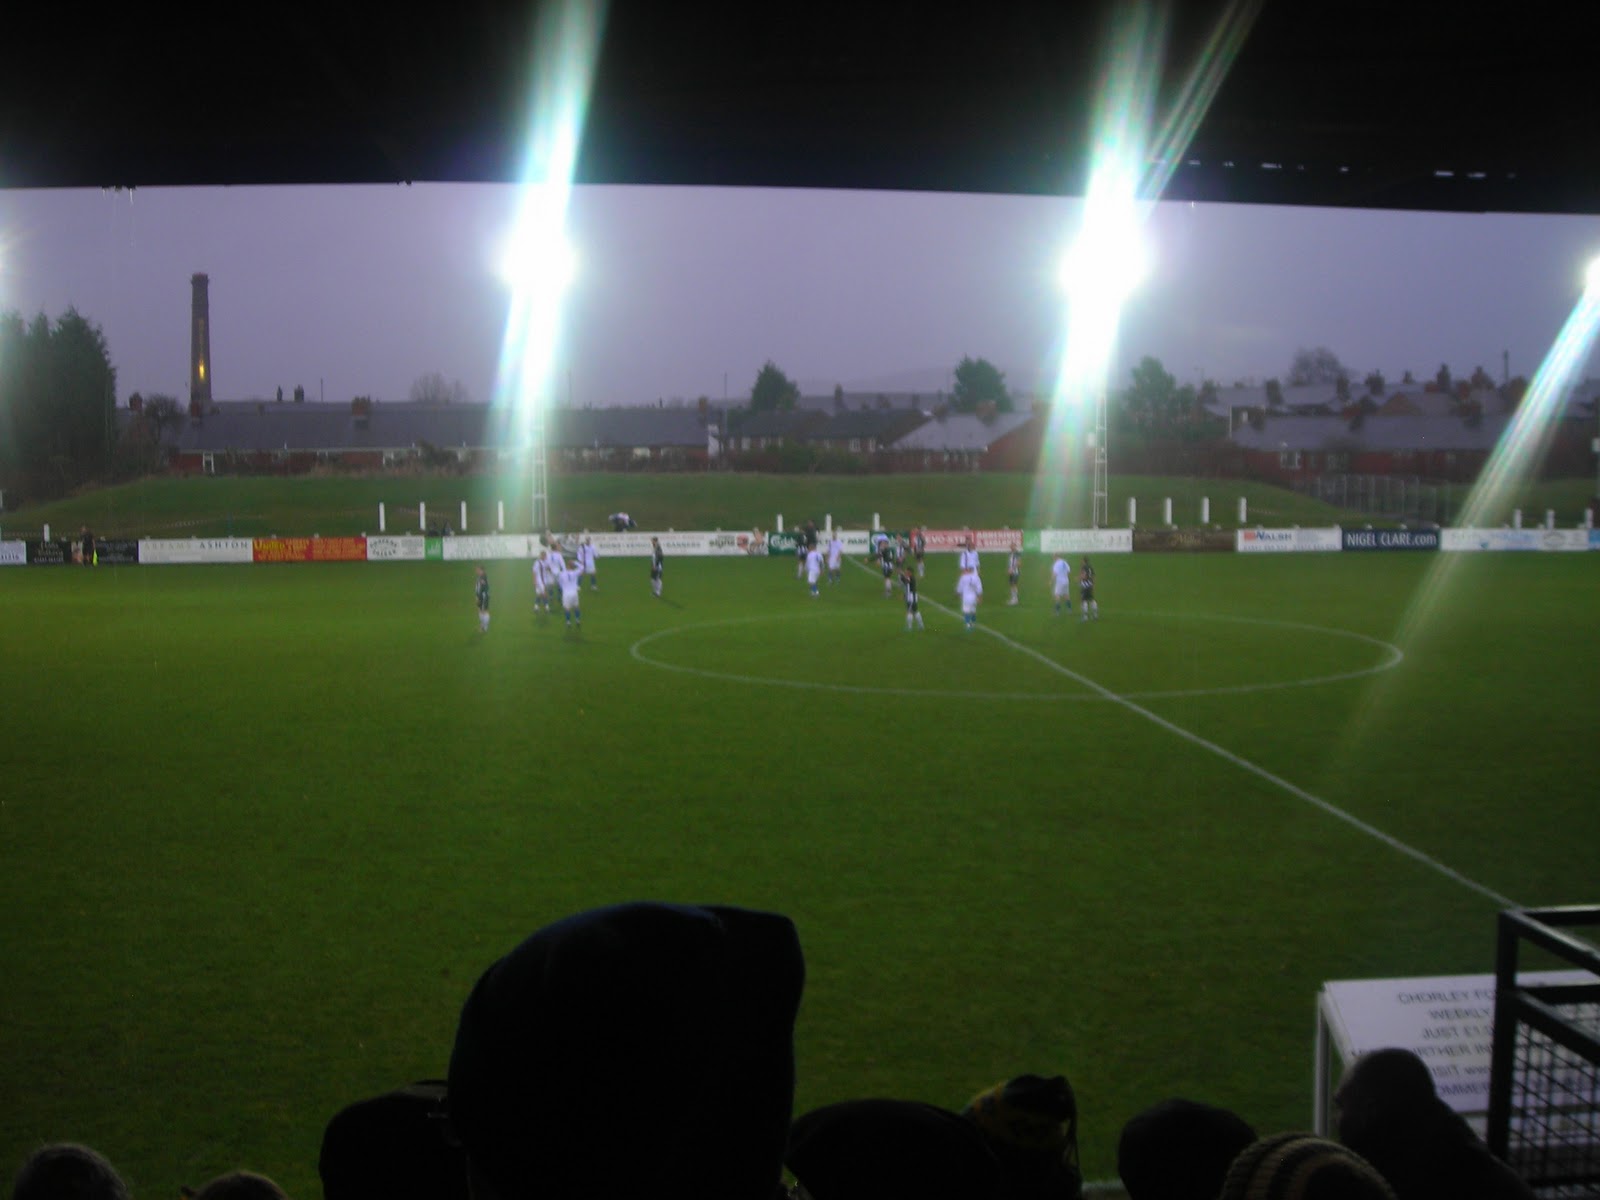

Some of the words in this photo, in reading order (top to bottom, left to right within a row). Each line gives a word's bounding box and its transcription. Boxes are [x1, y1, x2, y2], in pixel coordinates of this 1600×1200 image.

[1347, 533, 1376, 546] NIGEL
[1381, 532, 1437, 546] CLARE.com
[199, 541, 248, 550] ASHTON
[1398, 990, 1468, 1004] CHORLEY
[1429, 1008, 1490, 1020] WEEKLY
[1423, 1026, 1459, 1039] JUST
[1432, 1065, 1460, 1076] ISIT
